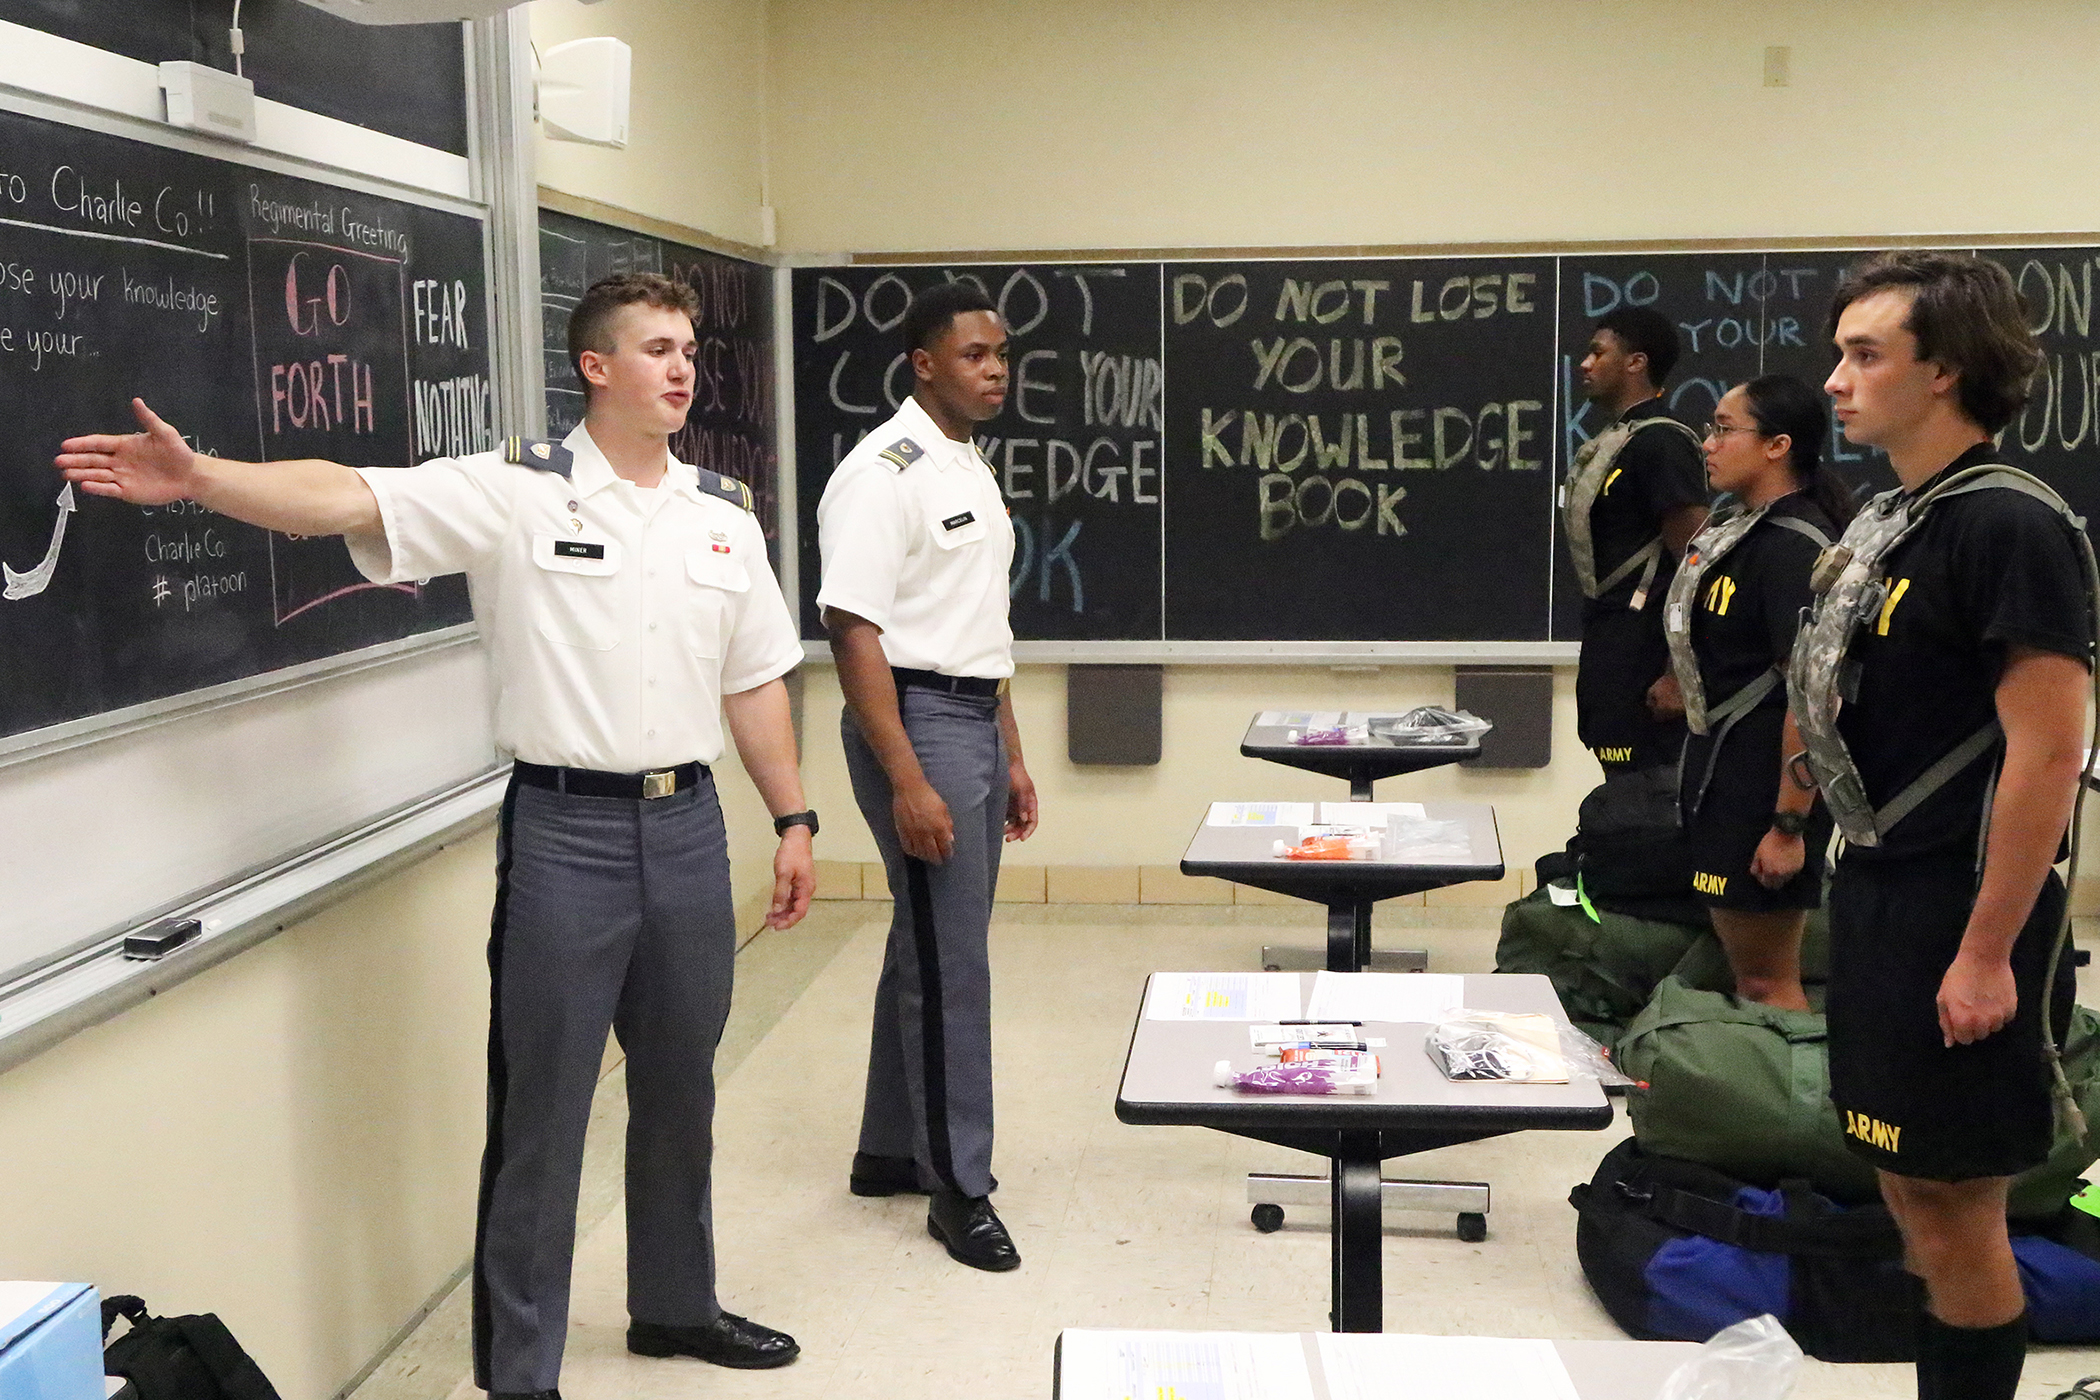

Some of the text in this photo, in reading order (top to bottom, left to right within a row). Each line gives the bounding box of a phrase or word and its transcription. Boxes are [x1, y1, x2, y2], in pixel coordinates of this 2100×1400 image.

[52, 165, 142, 228] Charlie
[250, 183, 408, 265] Regimental Greeting
[50, 269, 105, 320] your
[285, 251, 351, 337] GO
[413, 279, 469, 350] FEAR
[812, 272, 914, 343] DO
[1172, 272, 1537, 328] DO NOT LOSE
[1582, 270, 1660, 318] DO
[1705, 267, 1819, 305] NOT
[1250, 335, 1408, 394] YOUR
[1678, 316, 1808, 354] YOUR
[271, 353, 375, 435] FORTH
[413, 372, 493, 460] NOTHING
[1080, 349, 1164, 432] YOUR
[1200, 399, 1544, 473] KNOWLEDGE
[1258, 472, 1409, 541] BOOK
[144, 531, 202, 564] Charlie
[184, 571, 248, 613] platoon
[1599, 746, 1633, 762] ARMY
[1692, 870, 1729, 896] ARMY
[1845, 1109, 1902, 1154] ARMY
